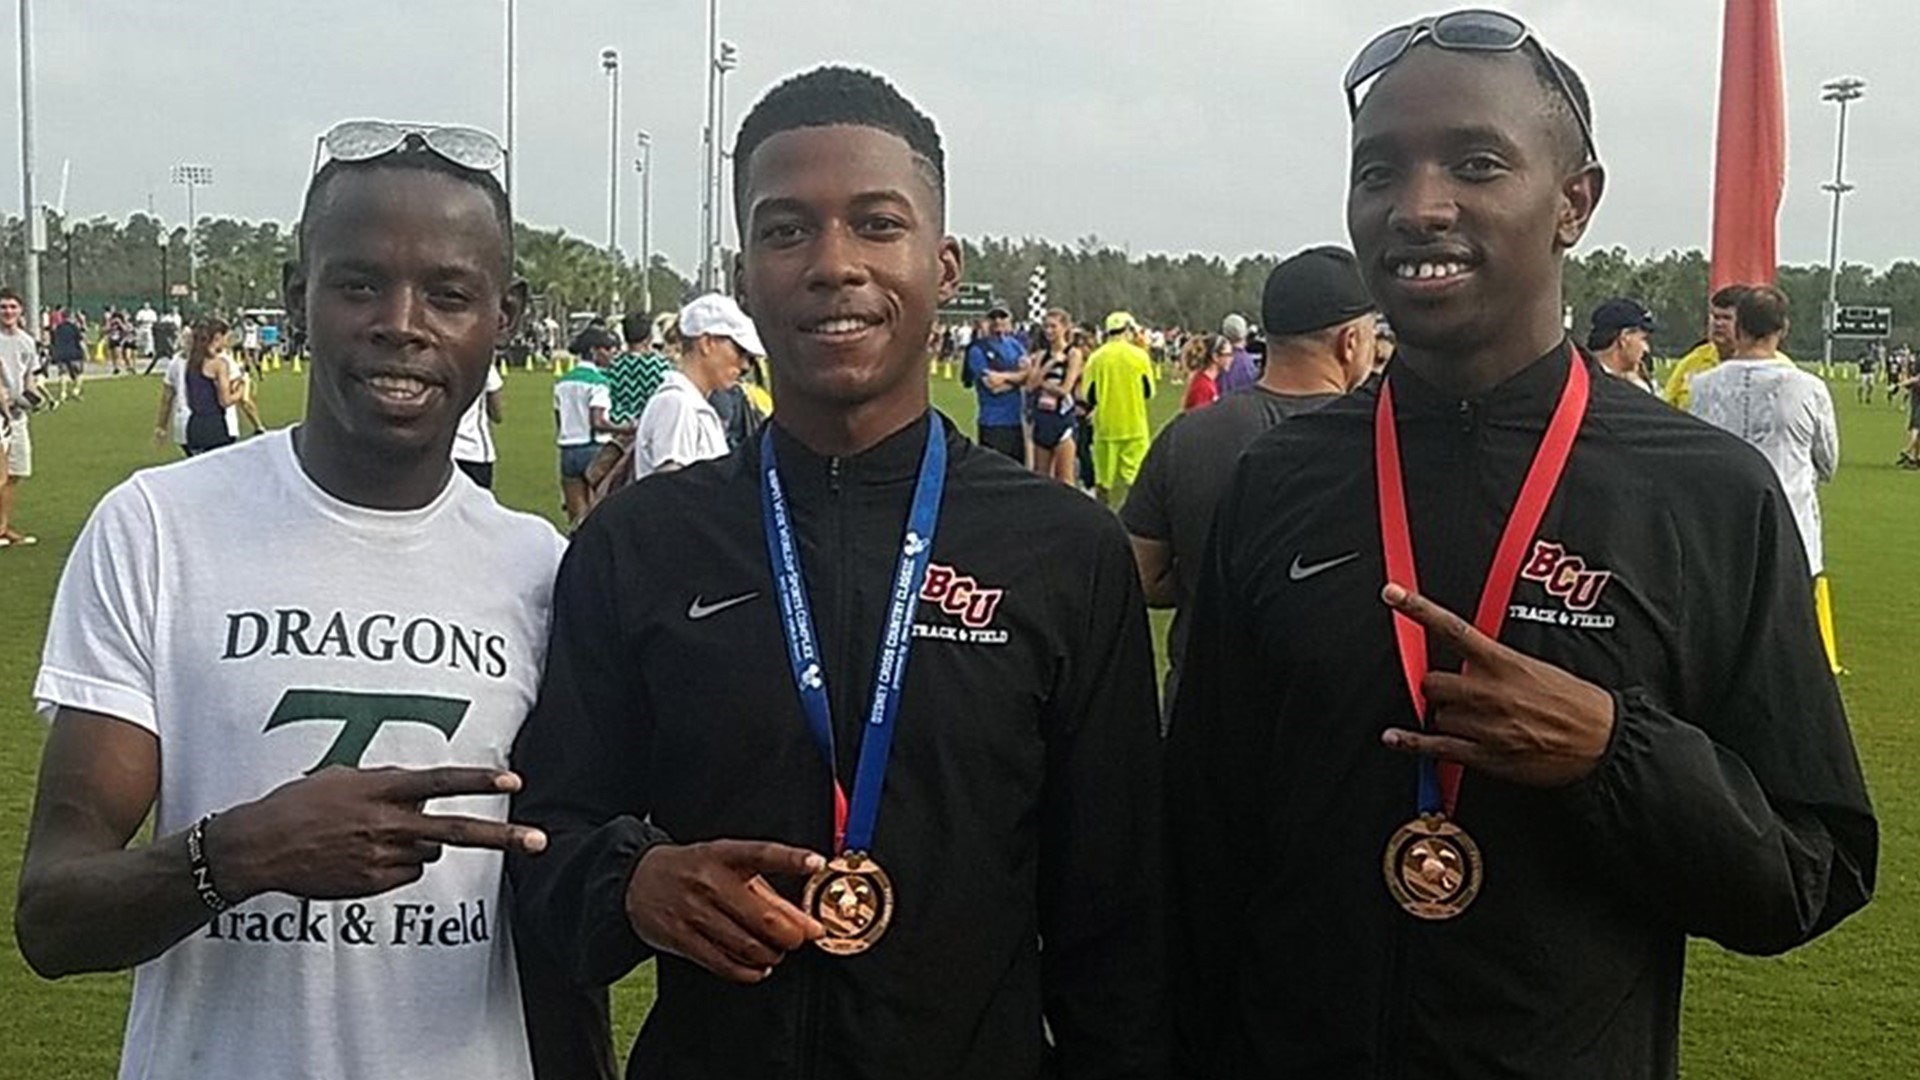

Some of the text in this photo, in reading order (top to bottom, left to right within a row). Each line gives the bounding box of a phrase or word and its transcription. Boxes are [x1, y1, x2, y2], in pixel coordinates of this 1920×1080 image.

[897, 558, 915, 600] CLASSIC
[919, 563, 1002, 627] BCU
[1520, 540, 1612, 611] BCU
[886, 600, 906, 647] COUNTRY
[912, 624, 957, 640] TRACK
[969, 630, 1008, 643] FIELD
[1509, 605, 1615, 628] TRACK & FIELD
[221, 608, 508, 678] DRAGONS
[879, 648, 896, 683] CROSS
[340, 903, 376, 945] &
[391, 900, 489, 947] Field
